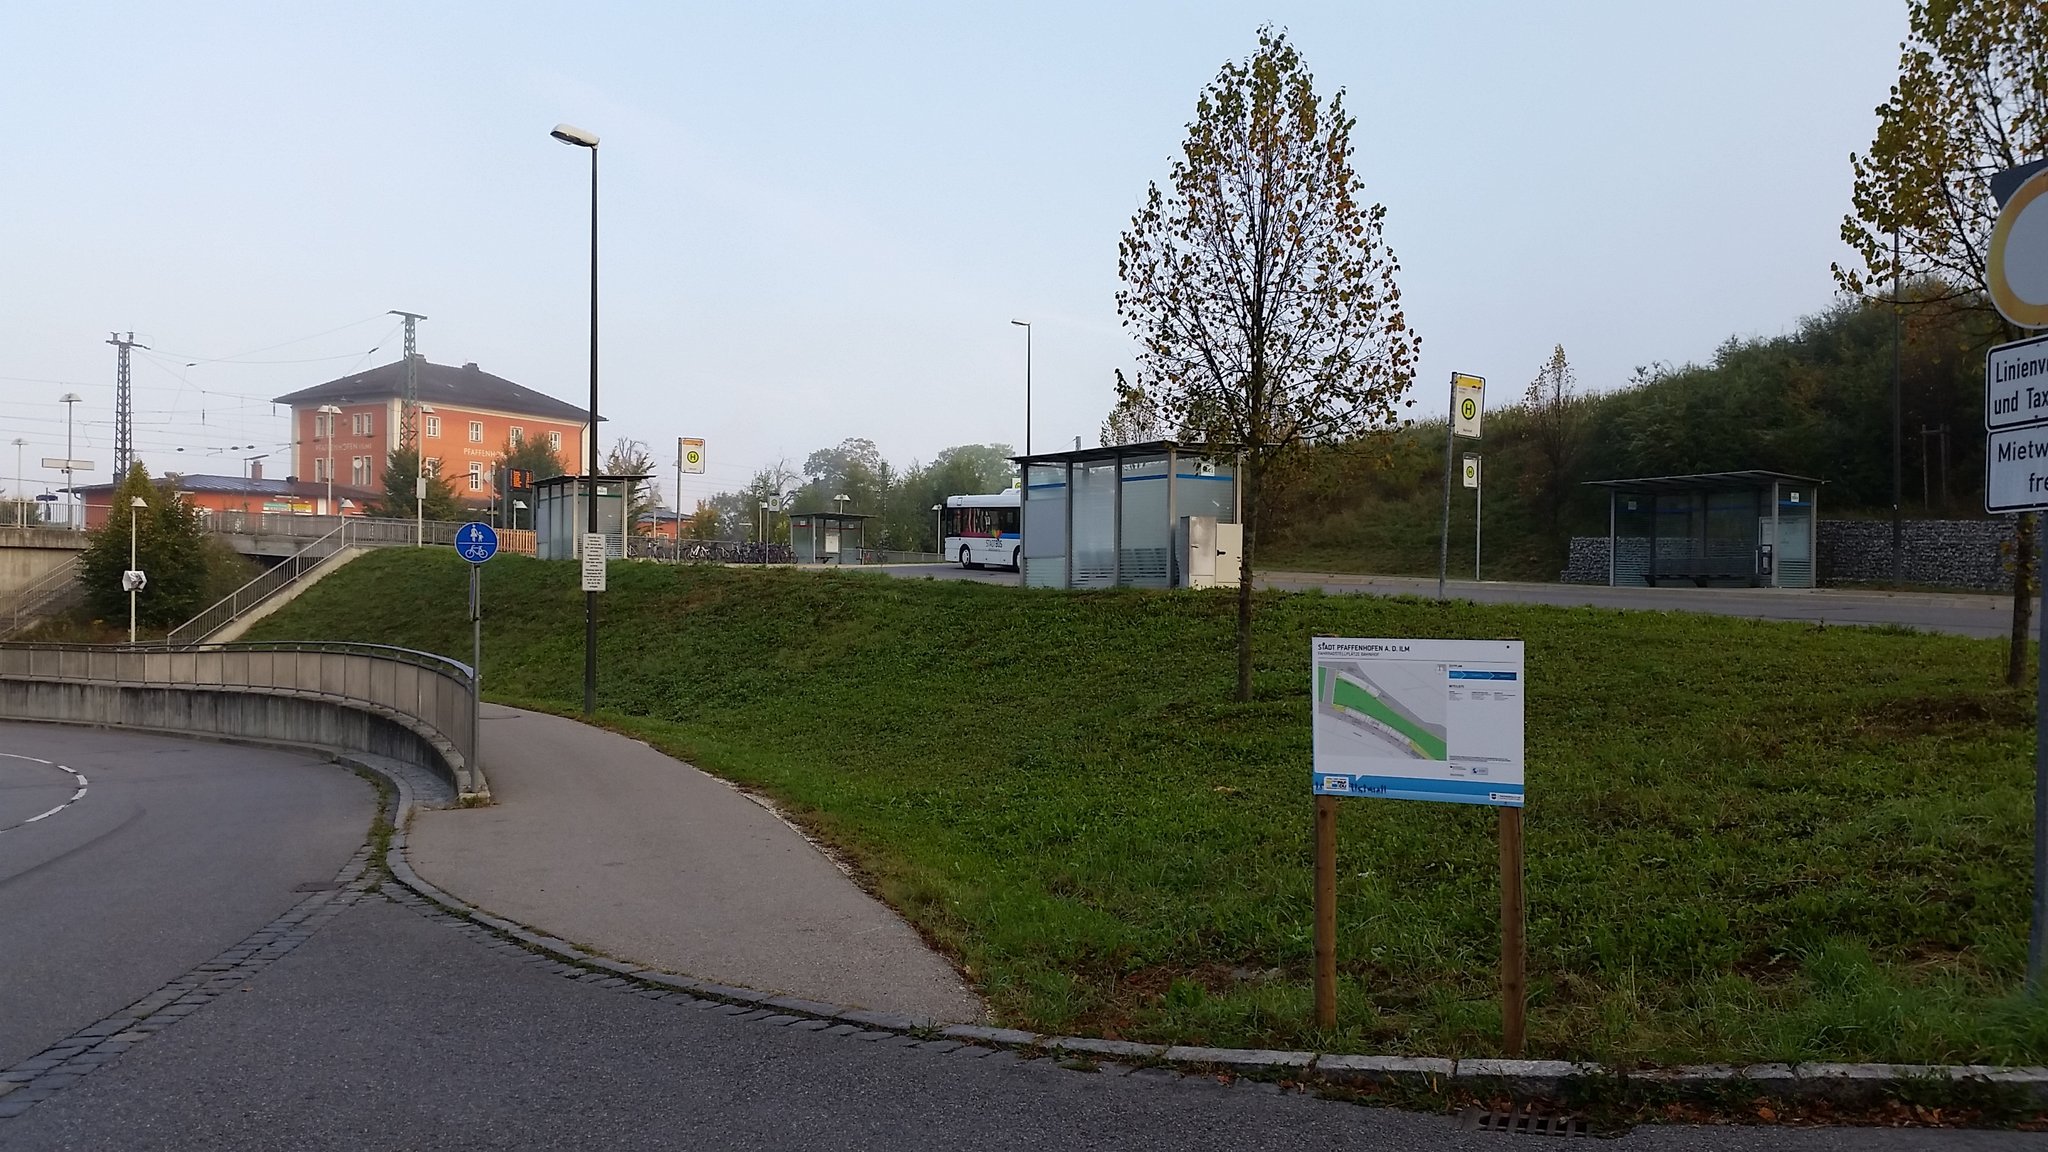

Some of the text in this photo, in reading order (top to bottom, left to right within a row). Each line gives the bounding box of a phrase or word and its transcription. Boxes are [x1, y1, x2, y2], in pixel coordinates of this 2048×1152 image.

[1996, 357, 2048, 383] Linienv
[1994, 390, 2018, 415] und
[1318, 642, 1335, 651] STADT
[1337, 643, 1383, 652] PFAFFENHOFEN
